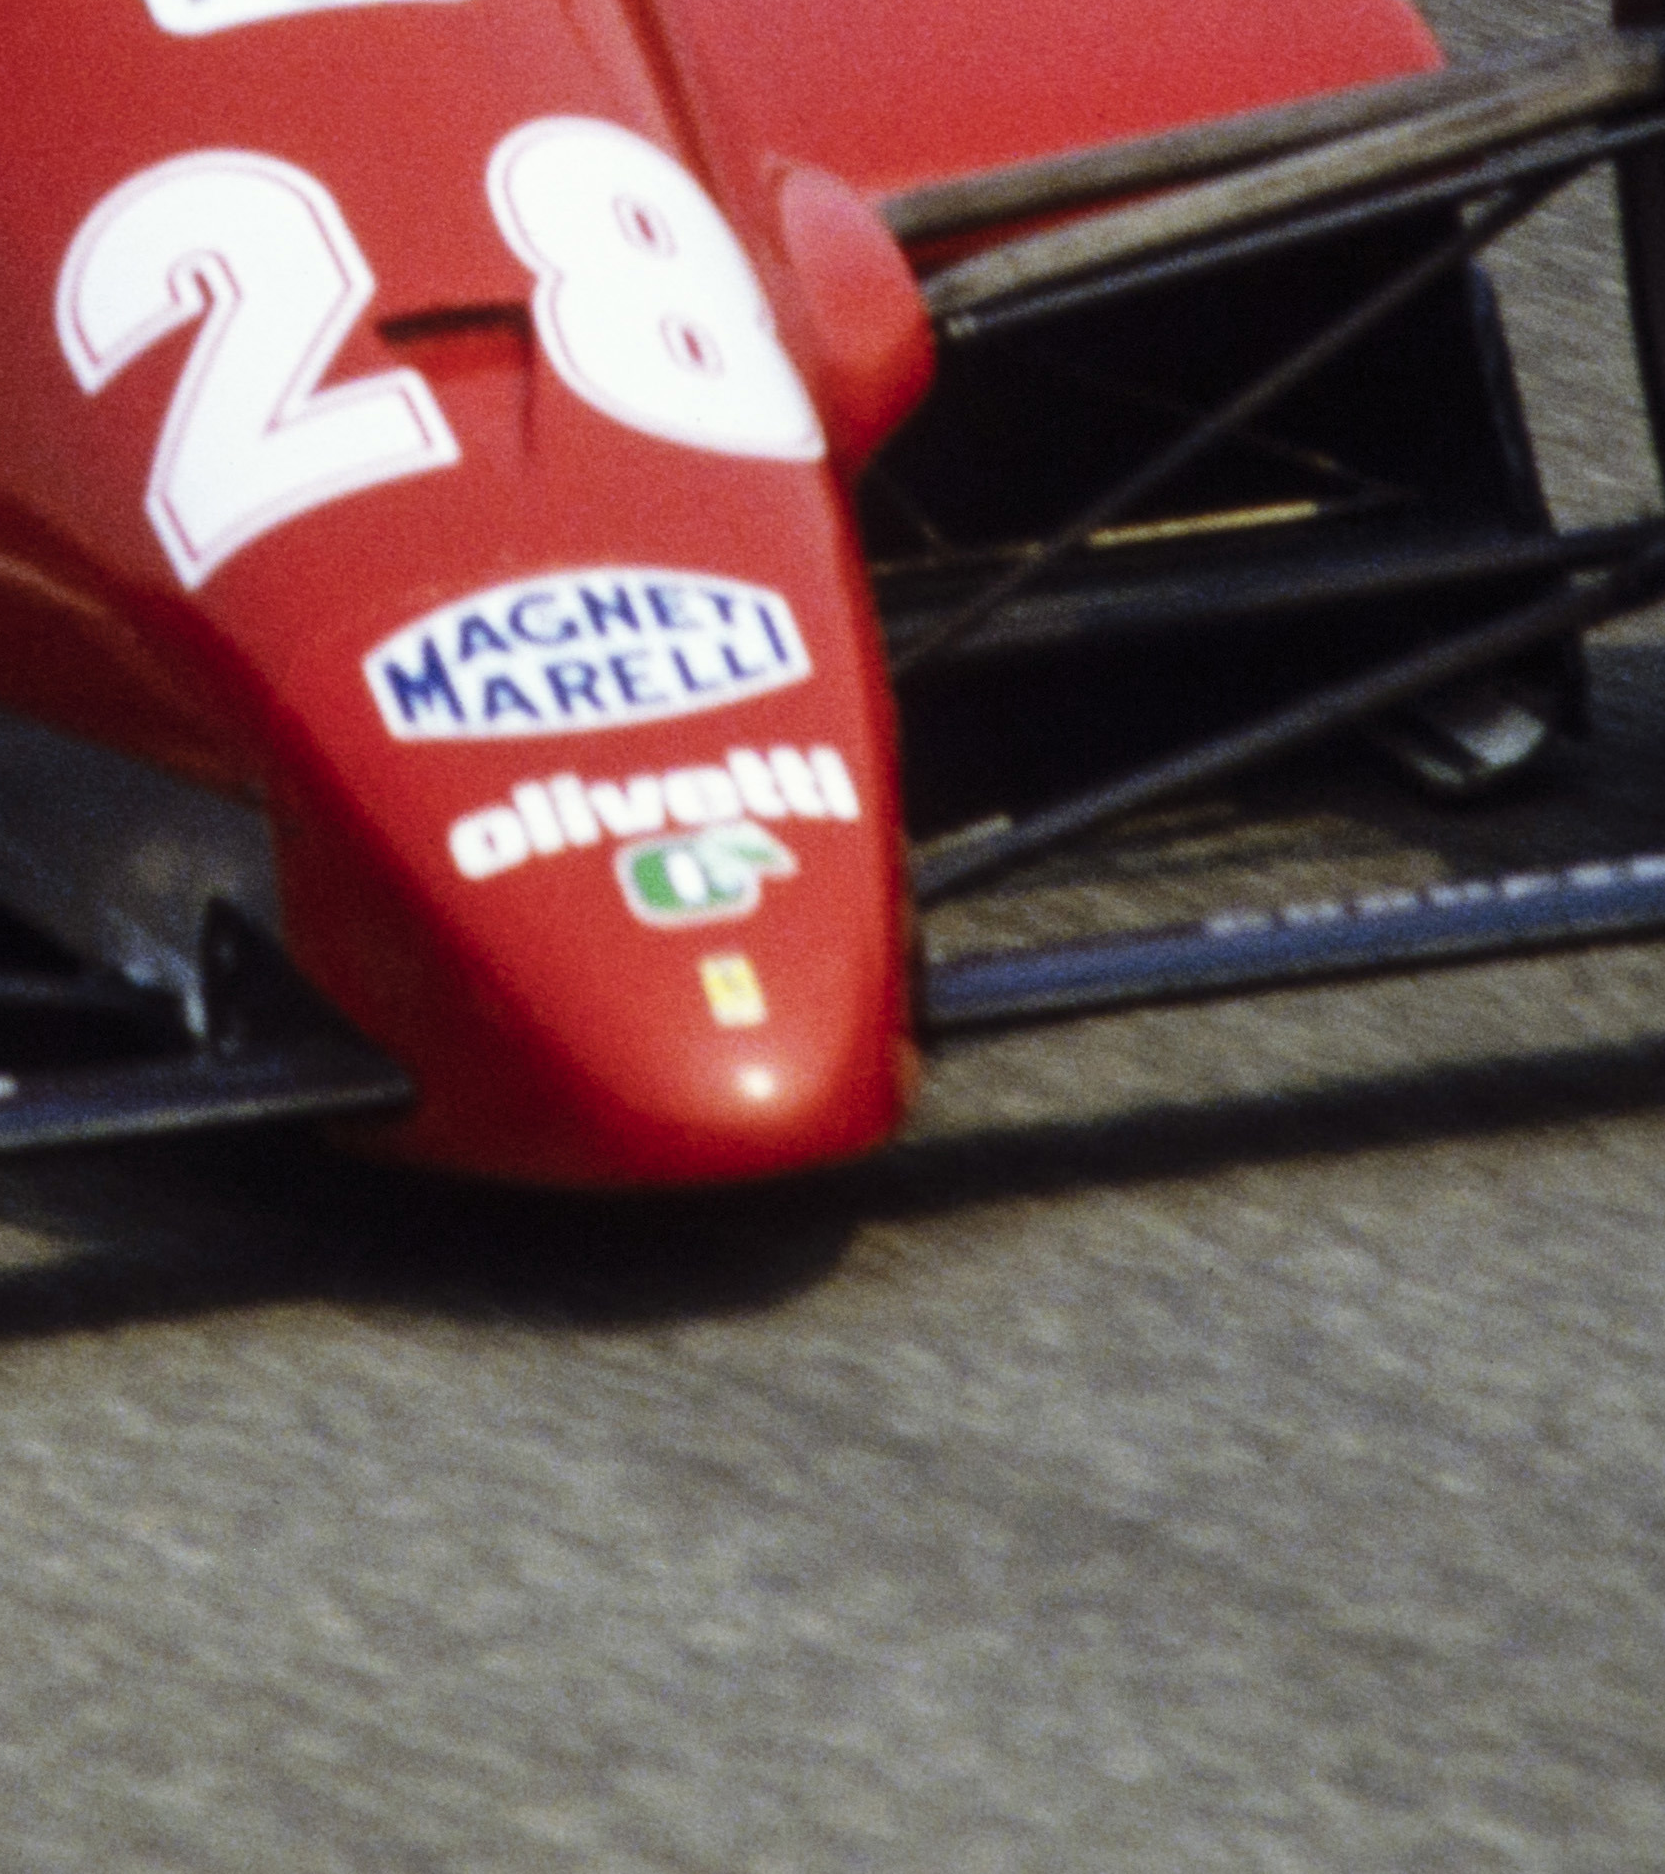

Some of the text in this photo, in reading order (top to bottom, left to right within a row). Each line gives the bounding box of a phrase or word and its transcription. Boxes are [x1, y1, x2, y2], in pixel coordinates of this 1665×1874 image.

[54, 114, 828, 591] 28
[383, 584, 790, 724] MAGNETI
[446, 743, 862, 882] olivetti
